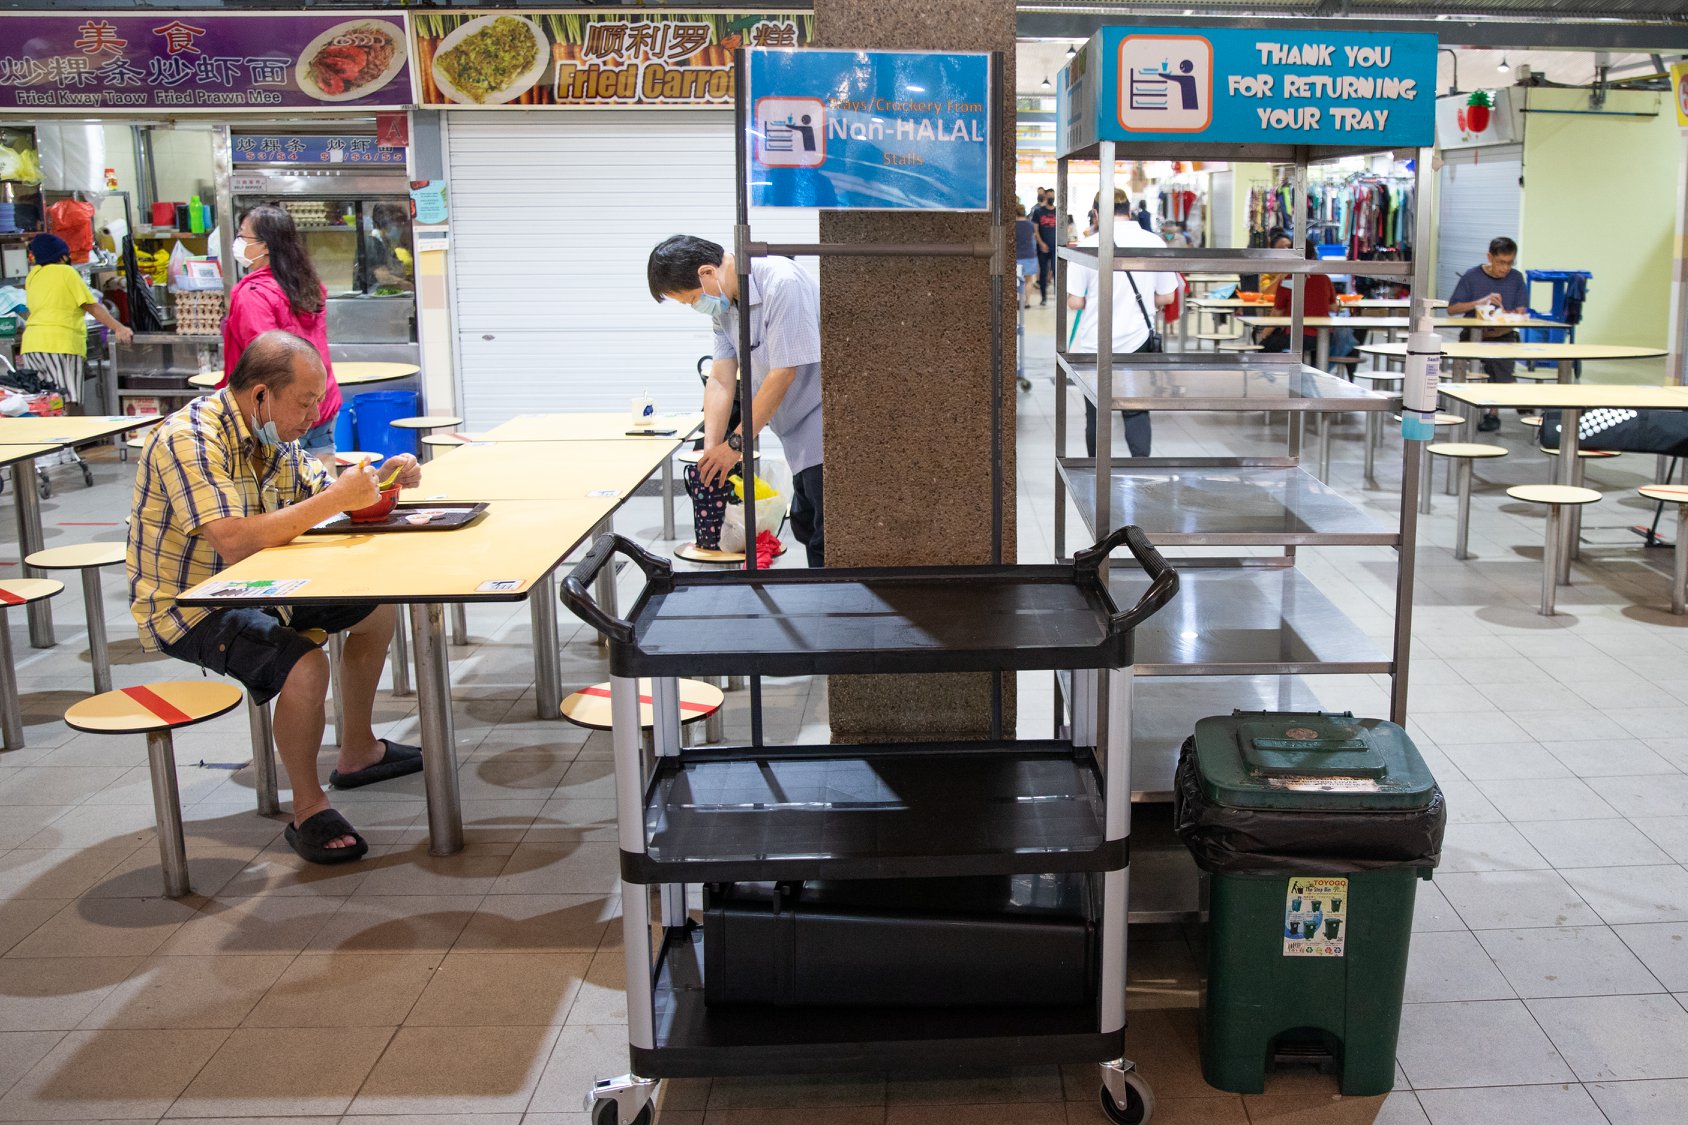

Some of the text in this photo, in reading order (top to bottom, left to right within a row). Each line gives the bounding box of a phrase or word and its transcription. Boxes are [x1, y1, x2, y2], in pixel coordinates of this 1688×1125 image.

[74, 20, 206, 55] 美食
[584, 23, 711, 60] 顺利罗
[1256, 42, 1391, 68] THANK YOU
[557, 63, 637, 99] Fried
[1228, 74, 1417, 101] FOR RETURNING
[16, 89, 282, 107] Fried Kway Taow Fried Prawn Mee
[947, 101, 983, 113] From
[828, 117, 983, 142] Non-HALAL
[1257, 106, 1389, 131] YOUR TRAY
[883, 152, 924, 166] Stalls
